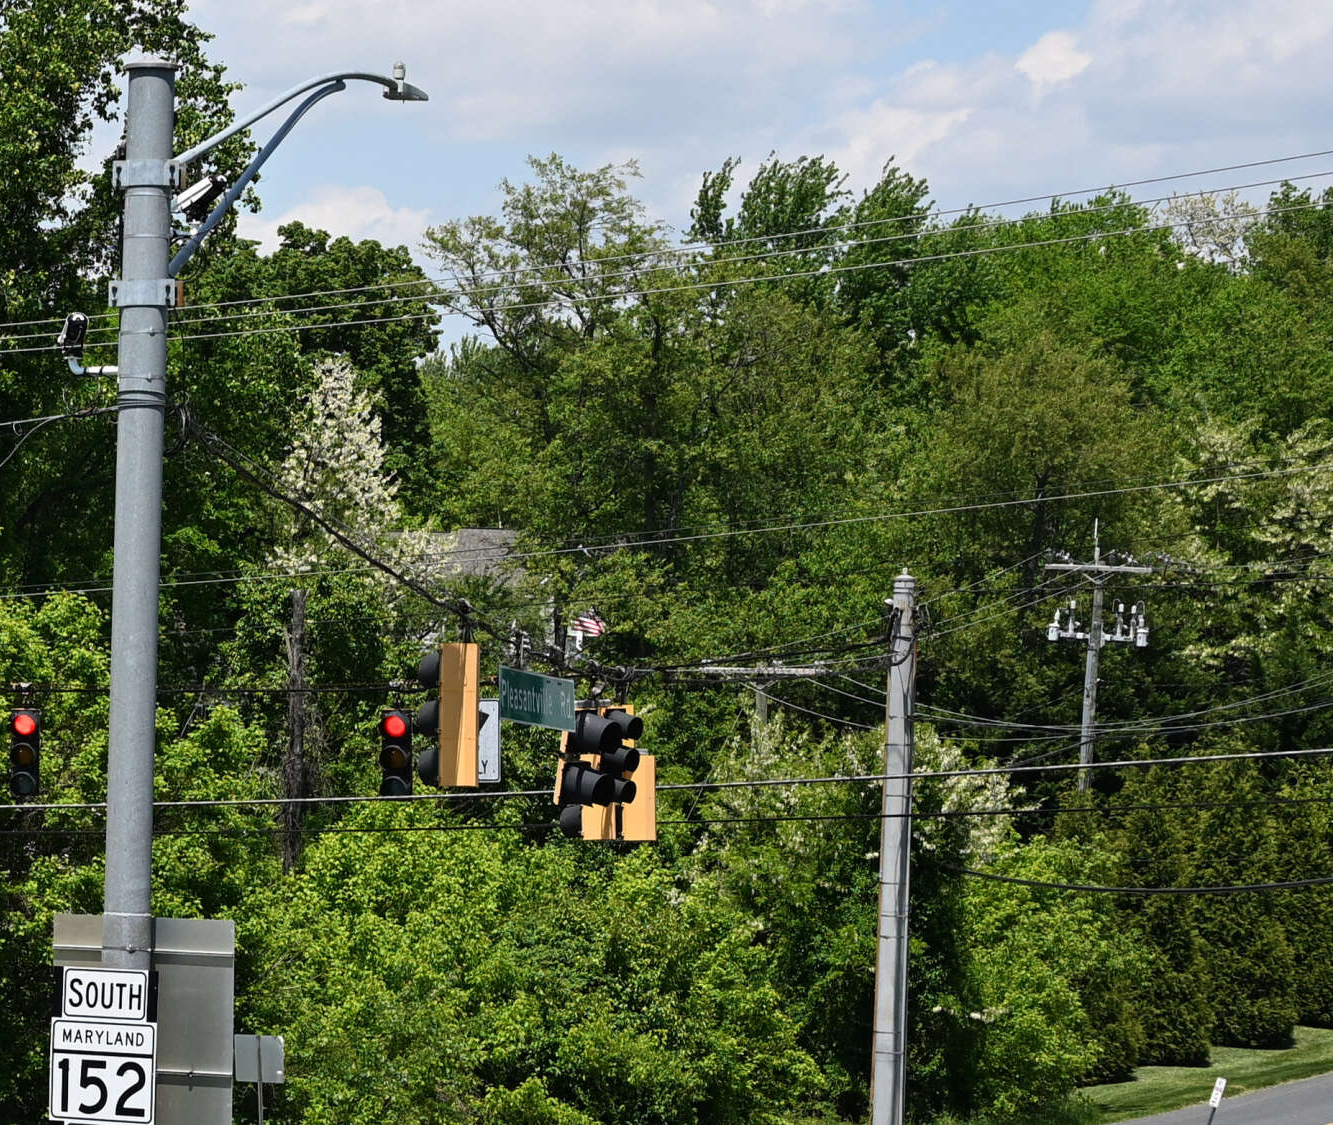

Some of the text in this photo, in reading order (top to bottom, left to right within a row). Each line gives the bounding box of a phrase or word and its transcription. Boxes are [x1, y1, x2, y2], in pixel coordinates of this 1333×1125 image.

[500, 678, 553, 715] Pleasantville
[68, 977, 143, 1011] SOUTH
[62, 1028, 145, 1048] MARYLAND
[57, 1057, 146, 1118] 152
